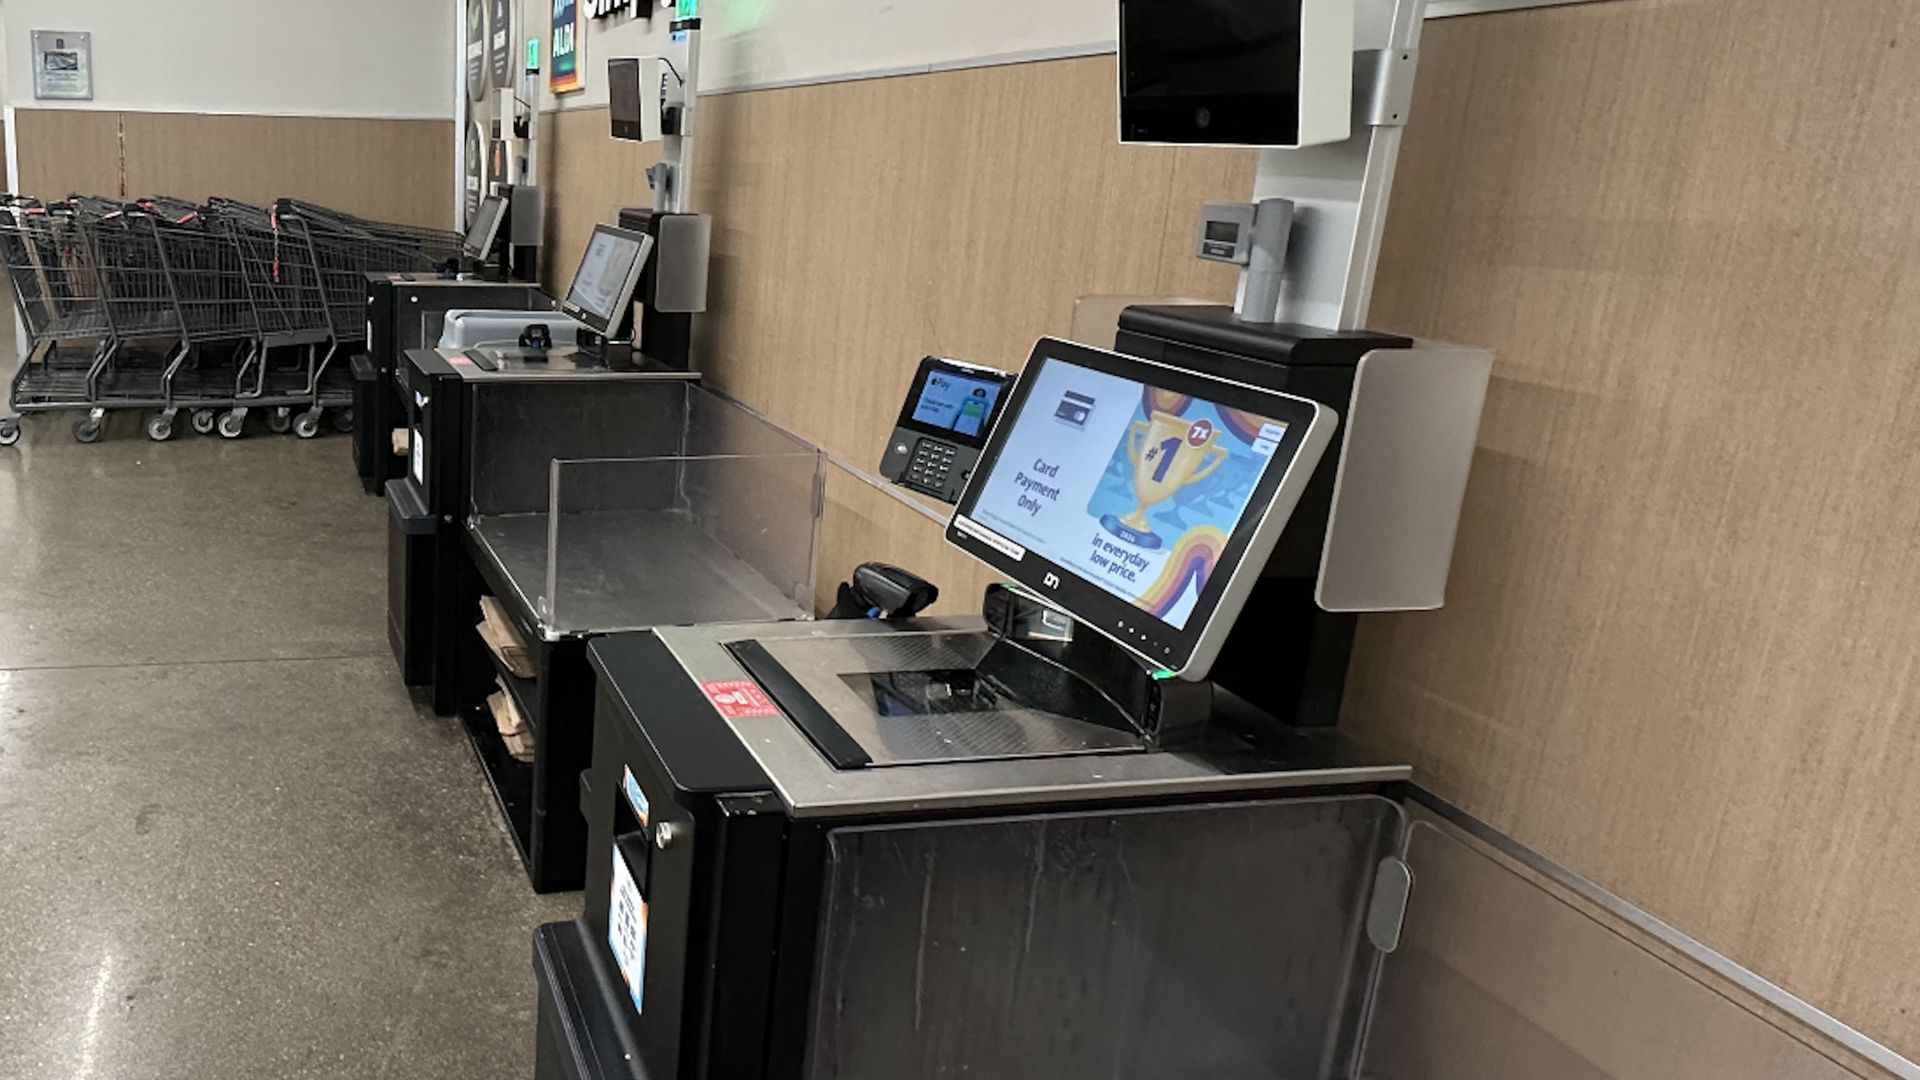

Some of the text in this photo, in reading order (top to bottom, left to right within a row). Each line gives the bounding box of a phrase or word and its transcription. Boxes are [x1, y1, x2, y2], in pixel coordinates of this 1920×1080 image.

[553, 22, 575, 57] ALDI
[1033, 458, 1060, 478] Card
[1014, 470, 1061, 501] Payment
[1017, 494, 1042, 517] Only
[1090, 549, 1136, 583] low price.
[1092, 532, 1150, 573] in everyday
